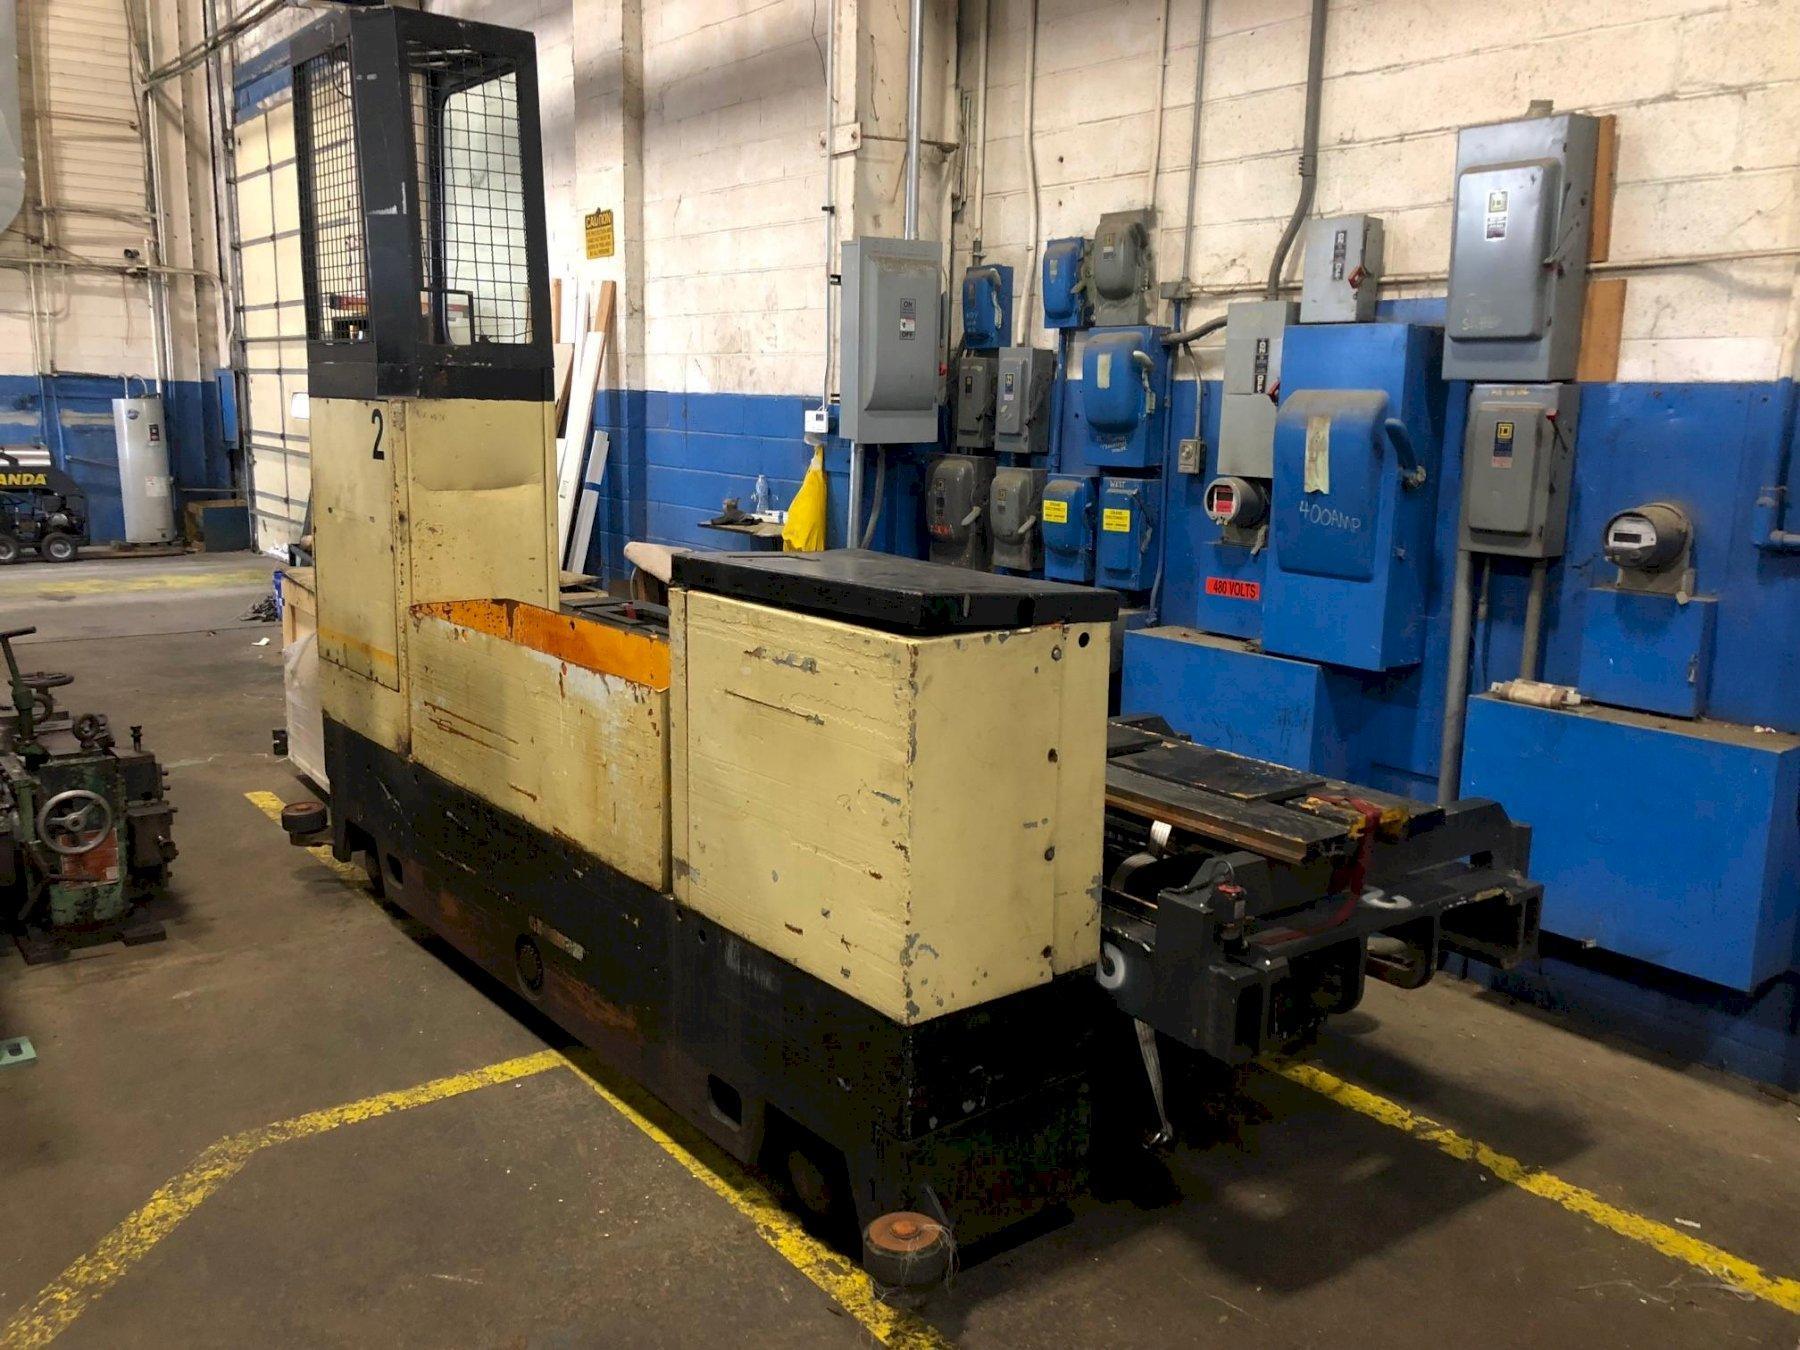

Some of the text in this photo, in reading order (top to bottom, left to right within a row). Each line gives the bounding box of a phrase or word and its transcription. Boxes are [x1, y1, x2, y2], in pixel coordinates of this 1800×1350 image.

[586, 212, 611, 228] CAUTION
[371, 408, 385, 460] 2
[1214, 579, 1256, 598] 480 VOLTS
